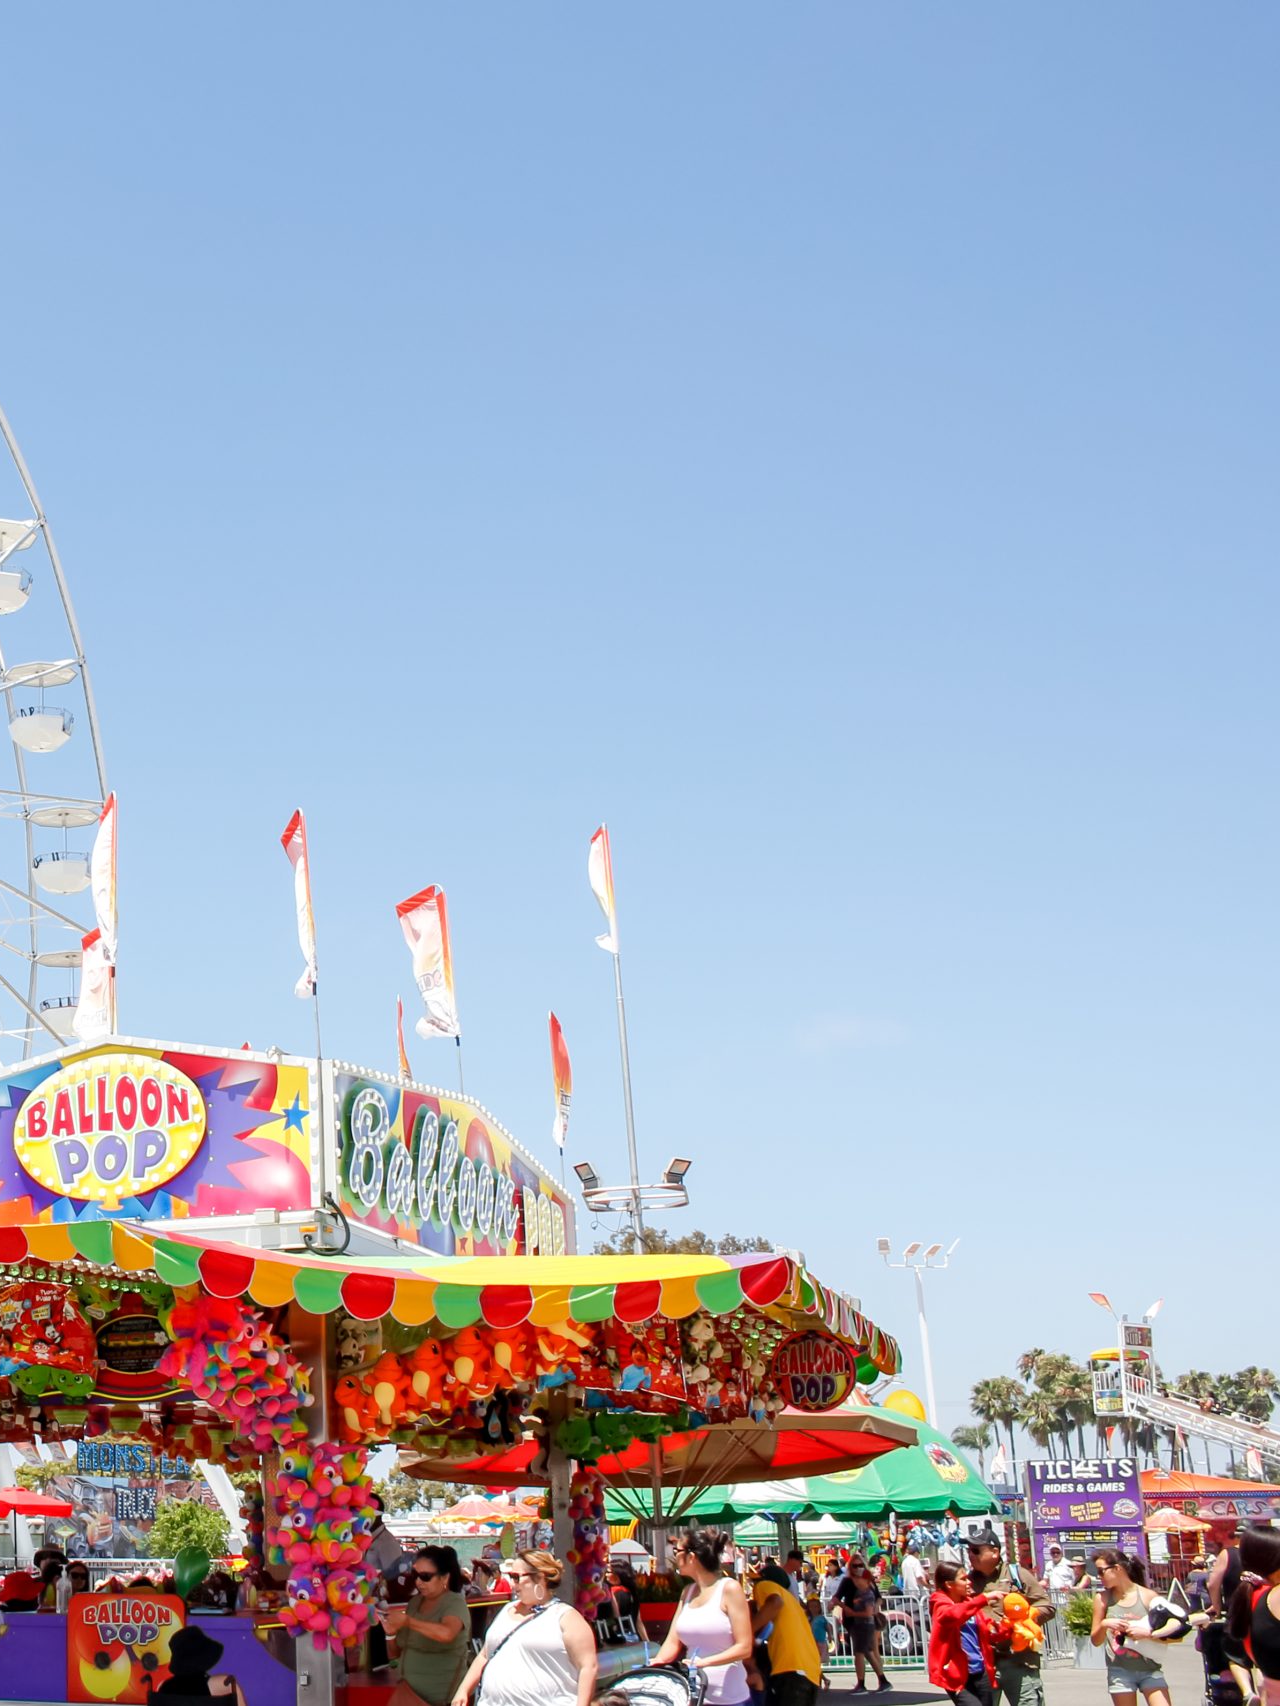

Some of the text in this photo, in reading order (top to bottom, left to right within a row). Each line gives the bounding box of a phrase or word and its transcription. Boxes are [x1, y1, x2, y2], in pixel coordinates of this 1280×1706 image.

[26, 1074, 191, 1139] BALLOON
[52, 1129, 169, 1186] POP
[350, 1087, 519, 1240] Balloon
[778, 1340, 845, 1375] BALLOON
[790, 1374, 836, 1405] POP
[1030, 1459, 1133, 1480] TICKETS
[1043, 1482, 1126, 1493] RIDES & GAMES
[1042, 1507, 1060, 1515] FUN
[1212, 1500, 1268, 1516] CARS
[83, 1599, 172, 1625] BALLOON
[97, 1622, 160, 1645] POP
